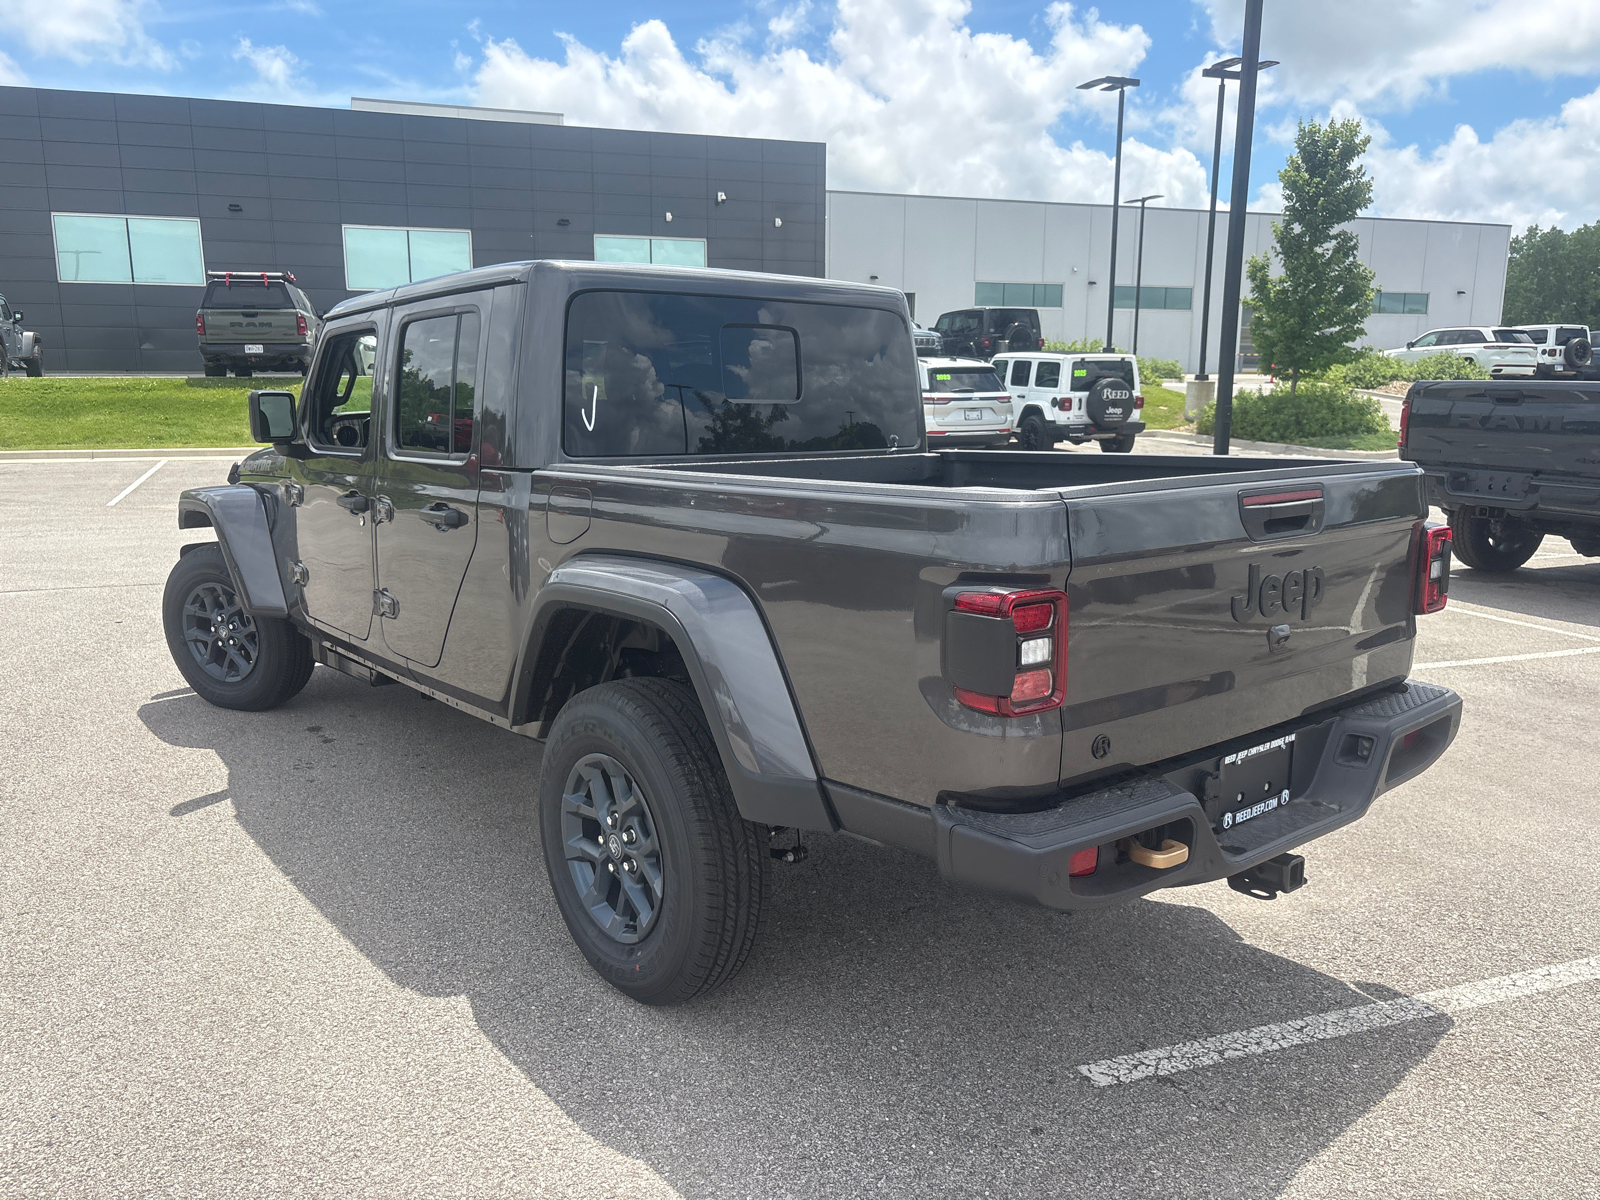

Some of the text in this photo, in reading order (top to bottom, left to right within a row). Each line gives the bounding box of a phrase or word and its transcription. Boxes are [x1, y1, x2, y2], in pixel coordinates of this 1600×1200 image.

[1105, 406, 1123, 415] Jeep
[1450, 412, 1564, 431] RAM
[1230, 563, 1325, 624] Jeep
[1224, 733, 1296, 765] REED JEEP CHRYSLER DODGE RAM
[1235, 797, 1278, 824] REEDJEEP.COM
